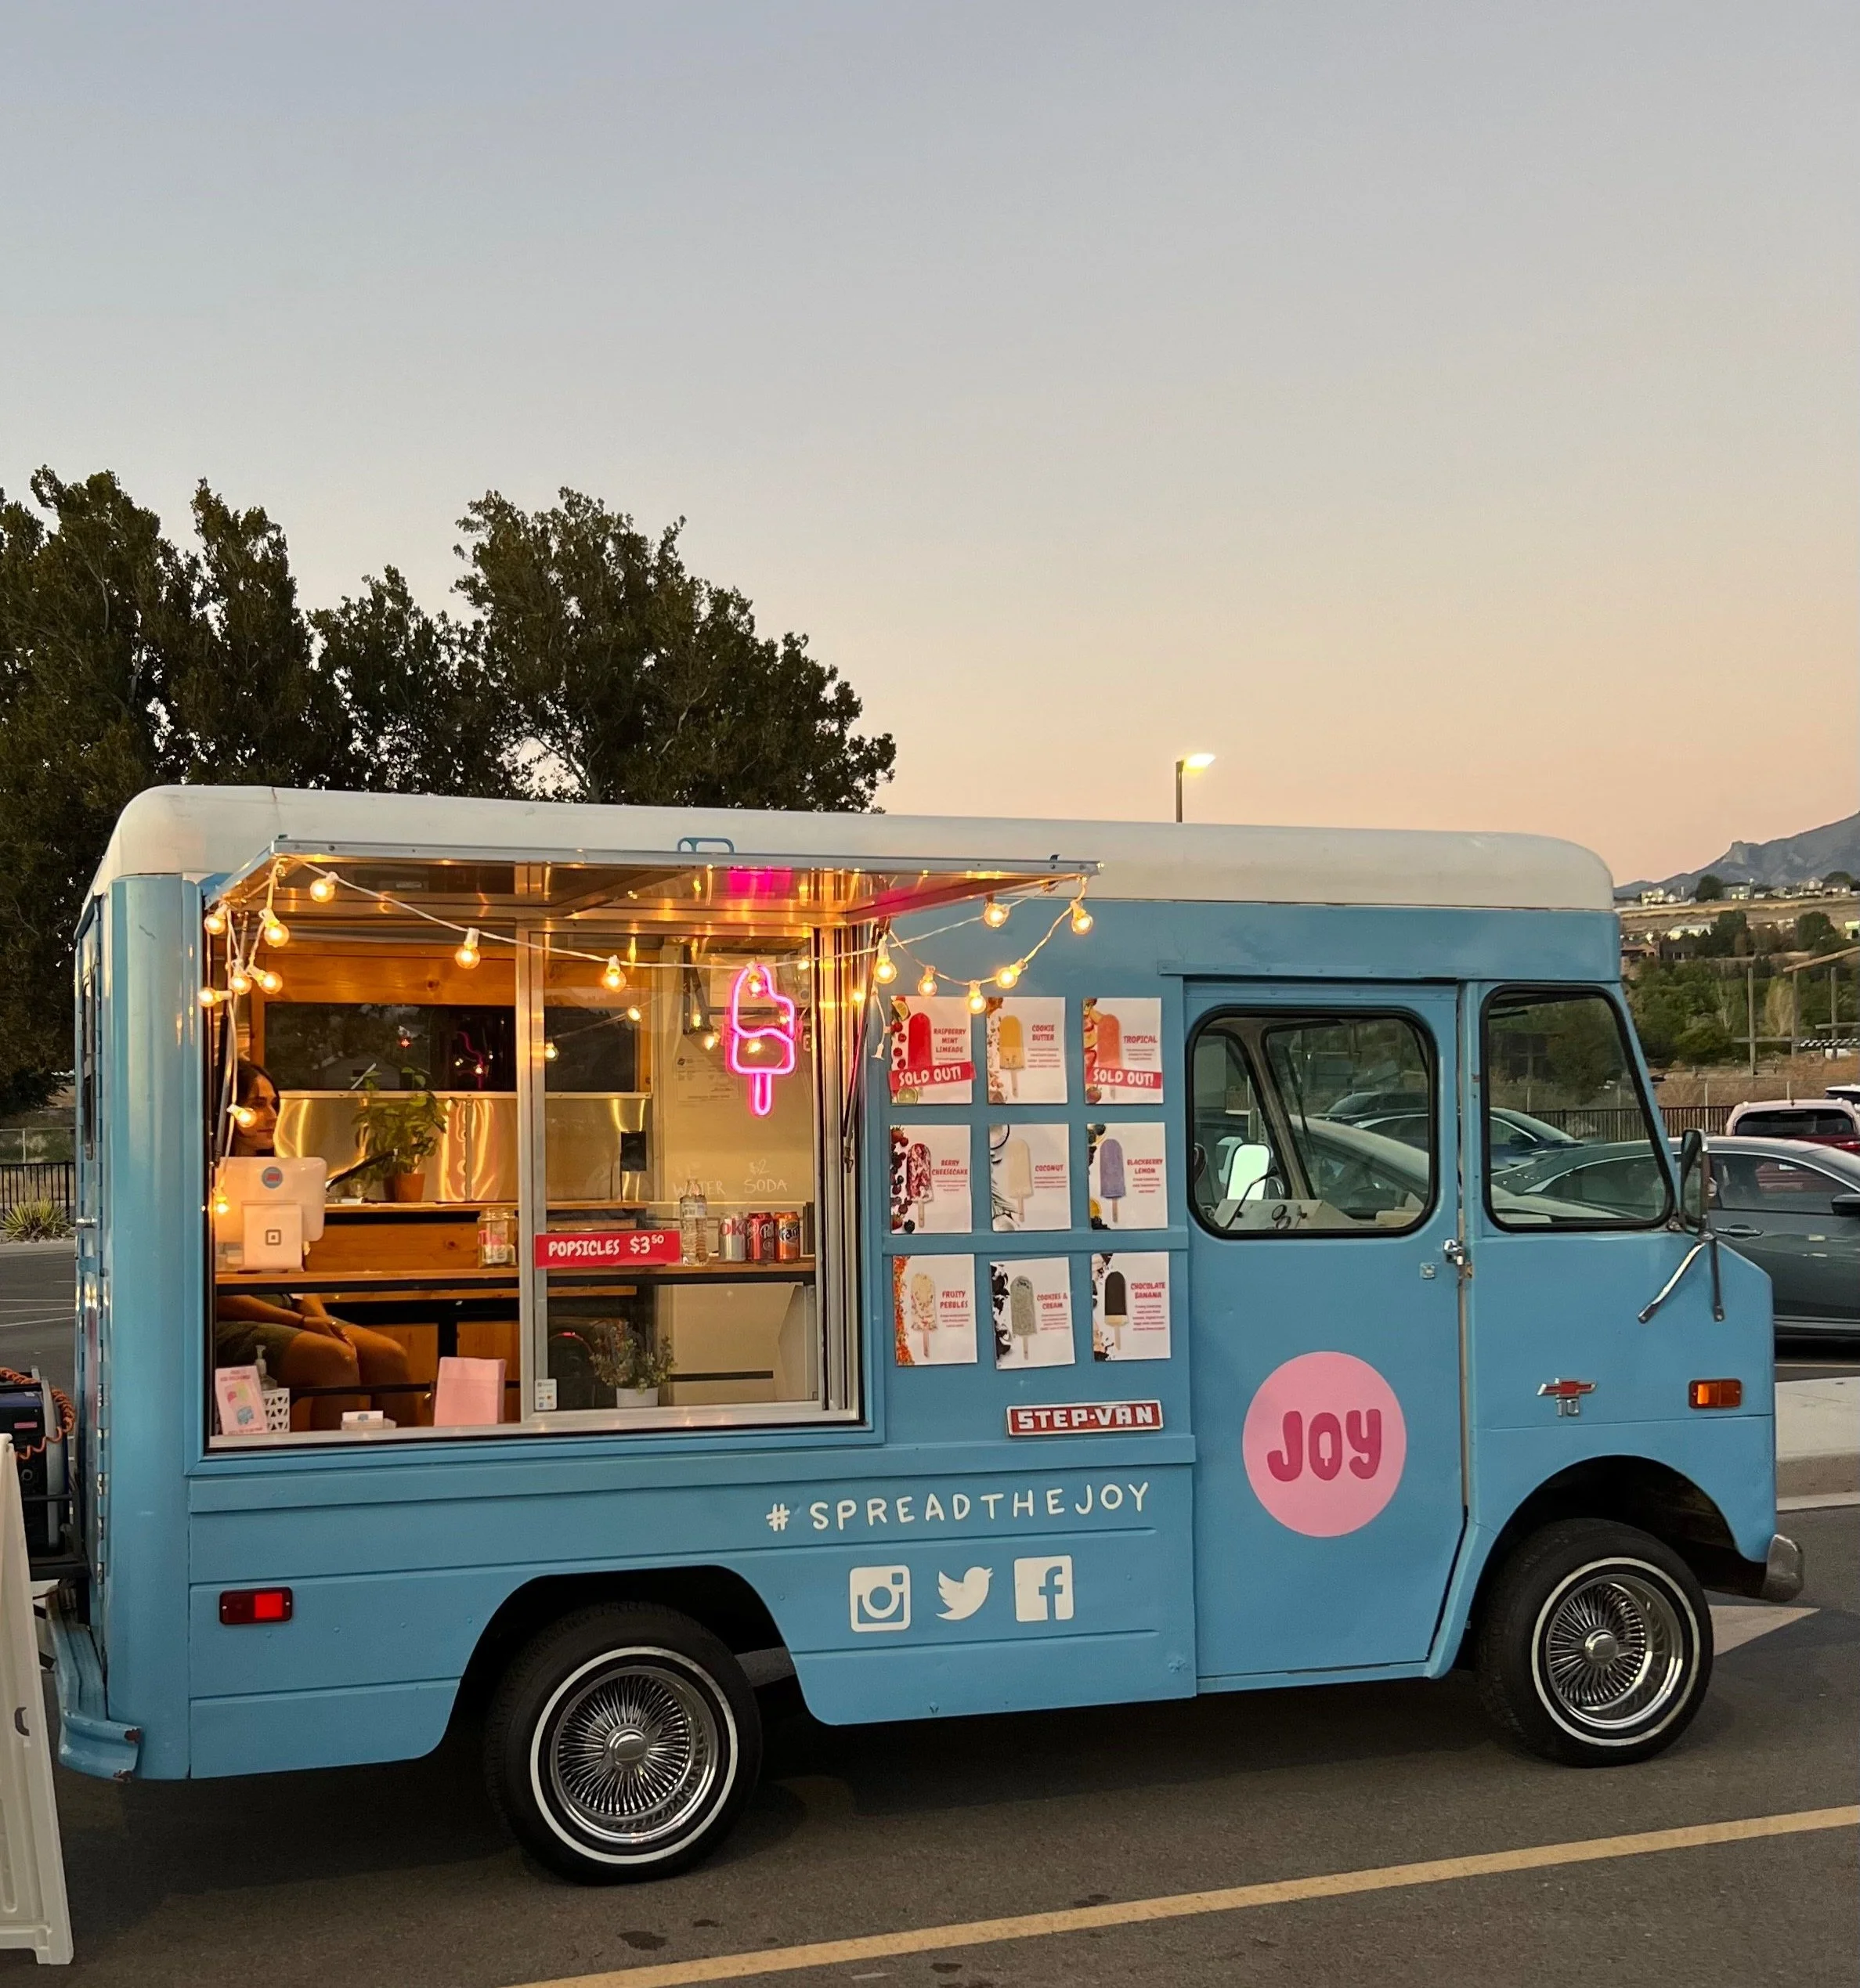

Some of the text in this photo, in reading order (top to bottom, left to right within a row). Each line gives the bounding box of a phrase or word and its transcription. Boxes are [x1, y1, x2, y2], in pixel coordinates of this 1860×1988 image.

[1123, 1035, 1158, 1044] TROPICAL
[898, 1066, 961, 1087] SOLD OUT!
[1093, 1068, 1154, 1087] SOLD OUT!
[749, 1159, 771, 1176] $2
[743, 1178, 788, 1194] SODA
[548, 1239, 620, 1257] POPSICLES
[1130, 1282, 1165, 1290] CHOCOLATE
[942, 1290, 966, 1299] FRUITY
[1036, 1293, 1061, 1302] COOKIES
[940, 1301, 968, 1309] PEBBLES
[1019, 1405, 1153, 1430] STEP-VAN
[1266, 1409, 1382, 1482] JOY
